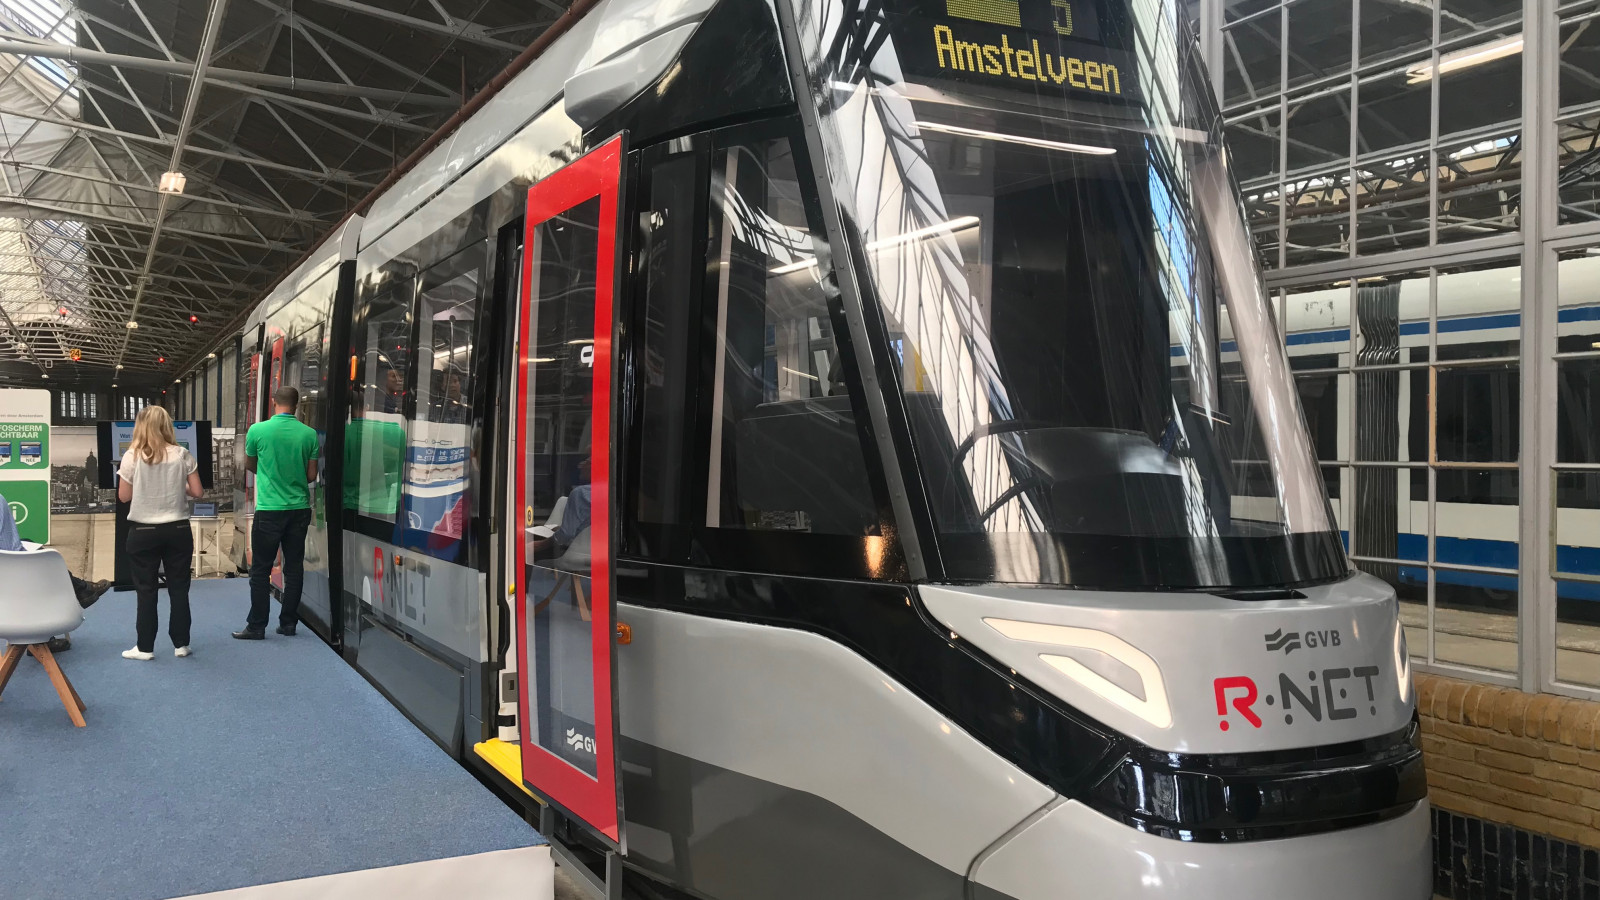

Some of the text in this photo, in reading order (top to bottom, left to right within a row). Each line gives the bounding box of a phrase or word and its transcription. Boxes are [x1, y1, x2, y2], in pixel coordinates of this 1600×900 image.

[934, 25, 1120, 94] Amstelveen
[70, 349, 80, 357] 24
[1305, 630, 1341, 648] GVB
